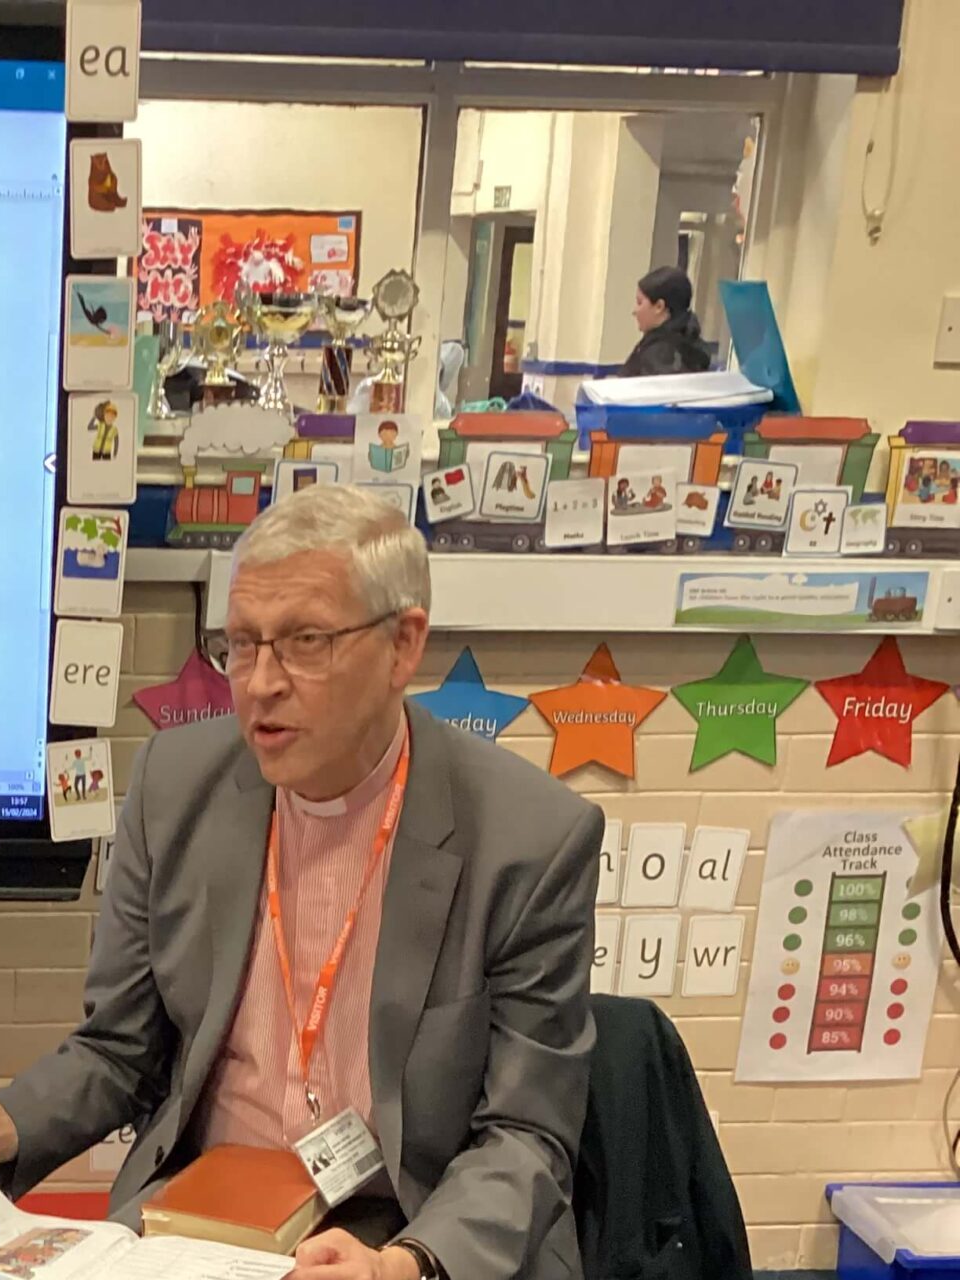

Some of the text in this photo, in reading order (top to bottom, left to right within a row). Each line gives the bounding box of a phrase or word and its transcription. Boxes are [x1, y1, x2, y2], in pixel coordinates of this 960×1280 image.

[78, 44, 130, 77] ea
[63, 662, 111, 687] ere
[697, 698, 777, 717] Thursday
[843, 697, 913, 724] Friday
[444, 712, 496, 737] sday
[553, 711, 636, 726] Wednesday
[382, 783, 405, 829] VISITOR
[844, 831, 878, 844] Class
[822, 845, 903, 858] Attendance
[642, 853, 665, 880] o
[698, 849, 731, 881] al
[841, 858, 878, 871] Track
[839, 883, 876, 896] 100%
[836, 933, 865, 946] 96%
[638, 938, 662, 979] y
[693, 946, 736, 967] wr
[829, 983, 858, 996] 94%
[307, 986, 328, 1030] VISITOR
[825, 1008, 854, 1021] 90%
[822, 1031, 851, 1044] 85%
